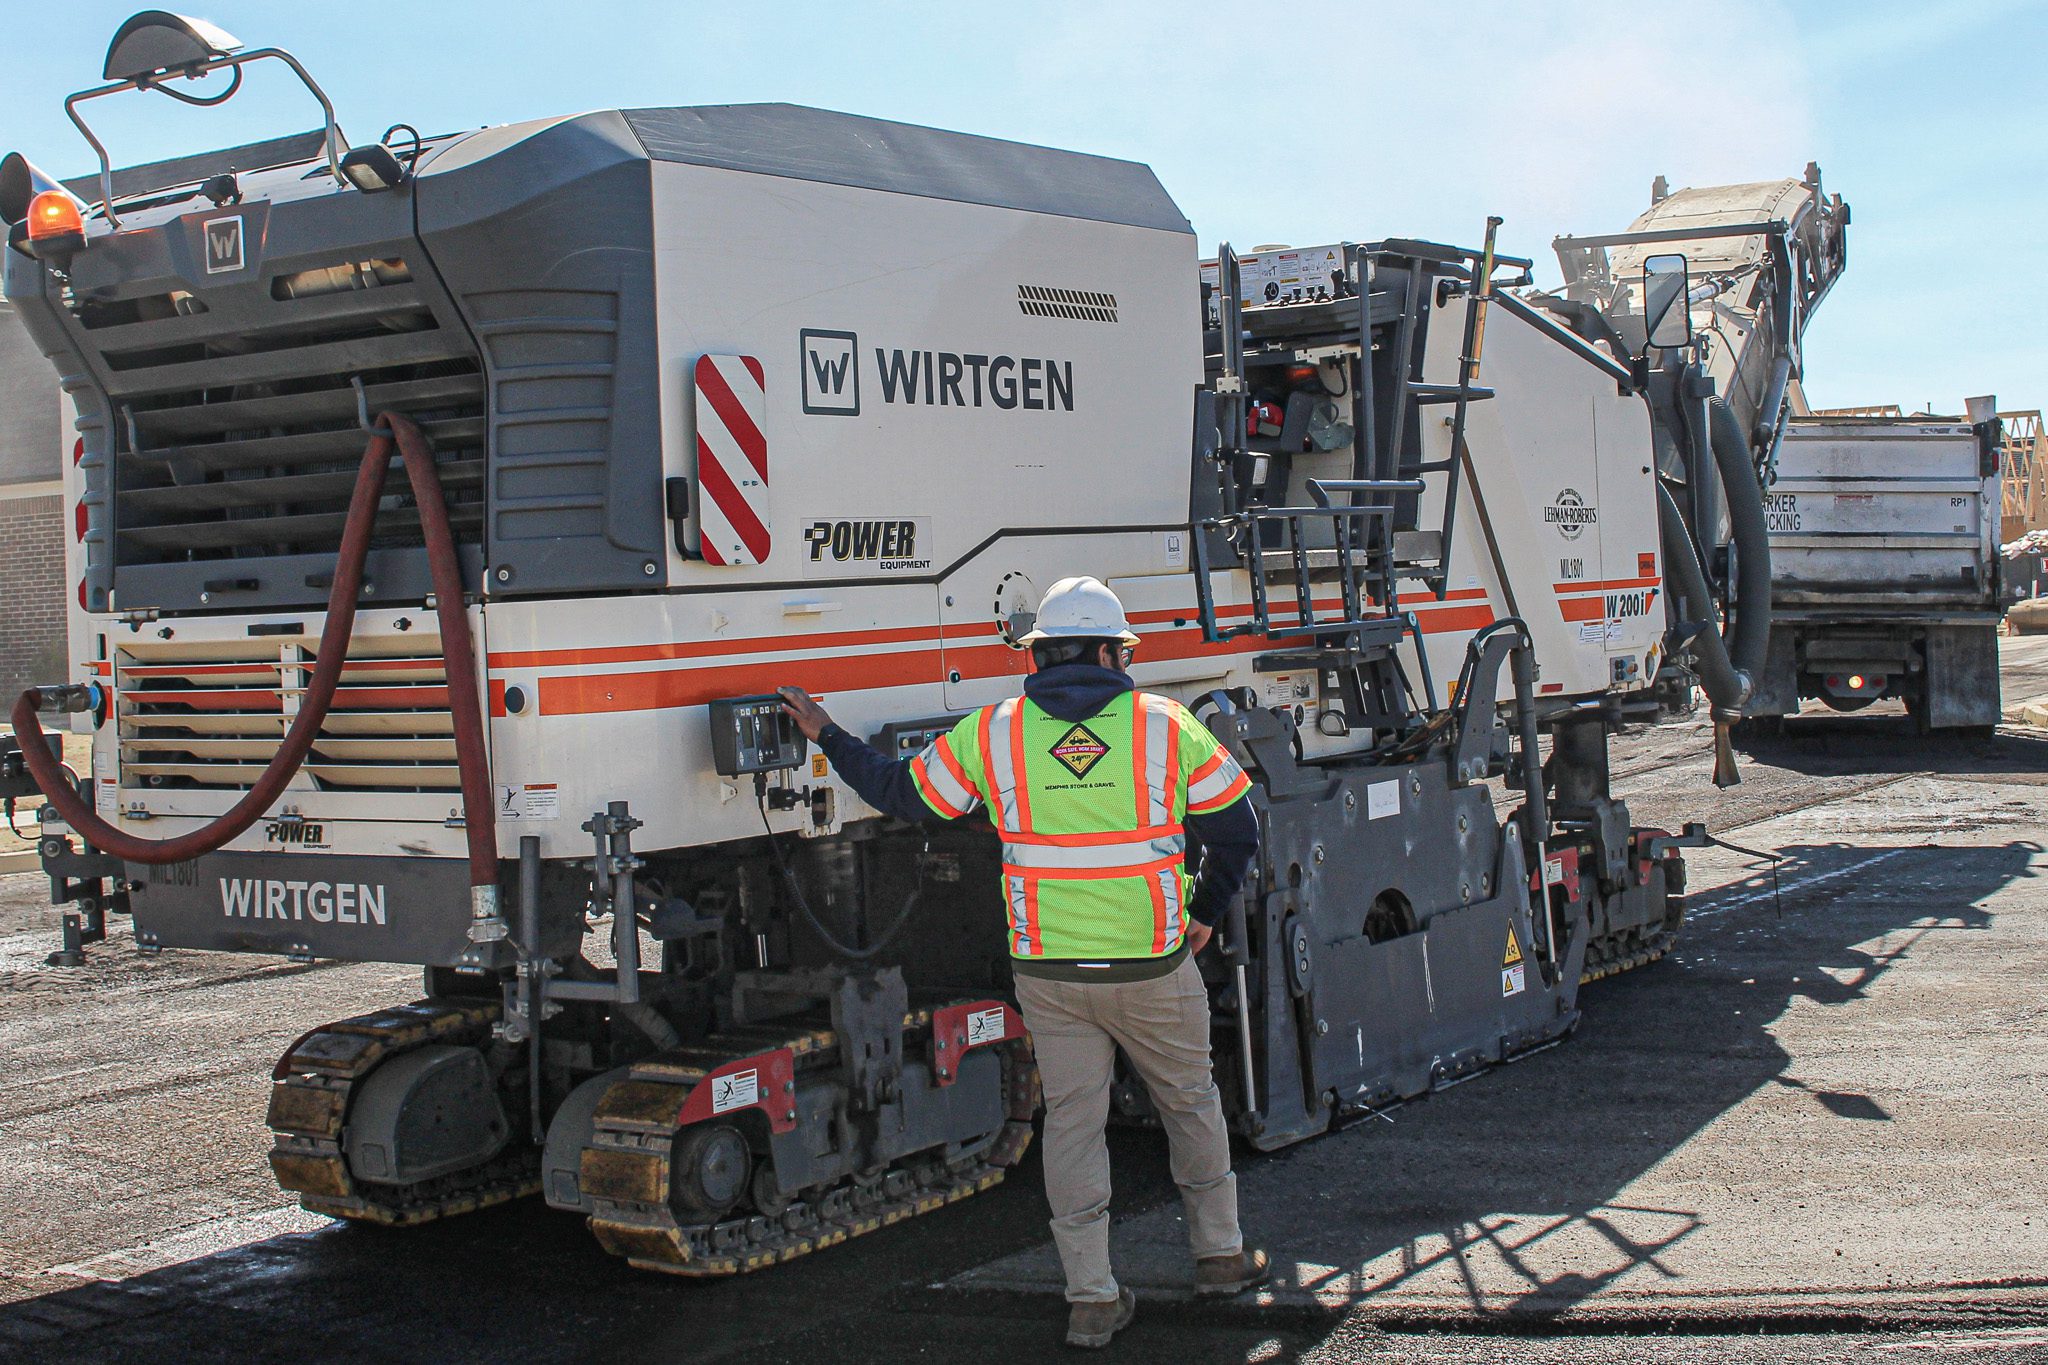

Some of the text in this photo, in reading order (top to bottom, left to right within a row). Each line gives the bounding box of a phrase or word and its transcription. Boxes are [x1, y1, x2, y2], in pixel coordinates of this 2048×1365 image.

[210, 228, 238, 260] W
[808, 349, 851, 395] W
[874, 347, 1075, 412] WIRTGEN
[1760, 494, 1797, 513] ARKER
[1950, 497, 1967, 507] RP1
[1544, 506, 1597, 524] LEHMAN-ROBERTS
[1764, 513, 1801, 531] CKING
[804, 520, 917, 562] POWER
[879, 560, 931, 570] EQUIPMENT
[1560, 558, 1583, 578] MIL1801
[1606, 591, 1644, 618] W 200i
[265, 823, 323, 843] POWER
[219, 877, 387, 925] WIRTGEN
